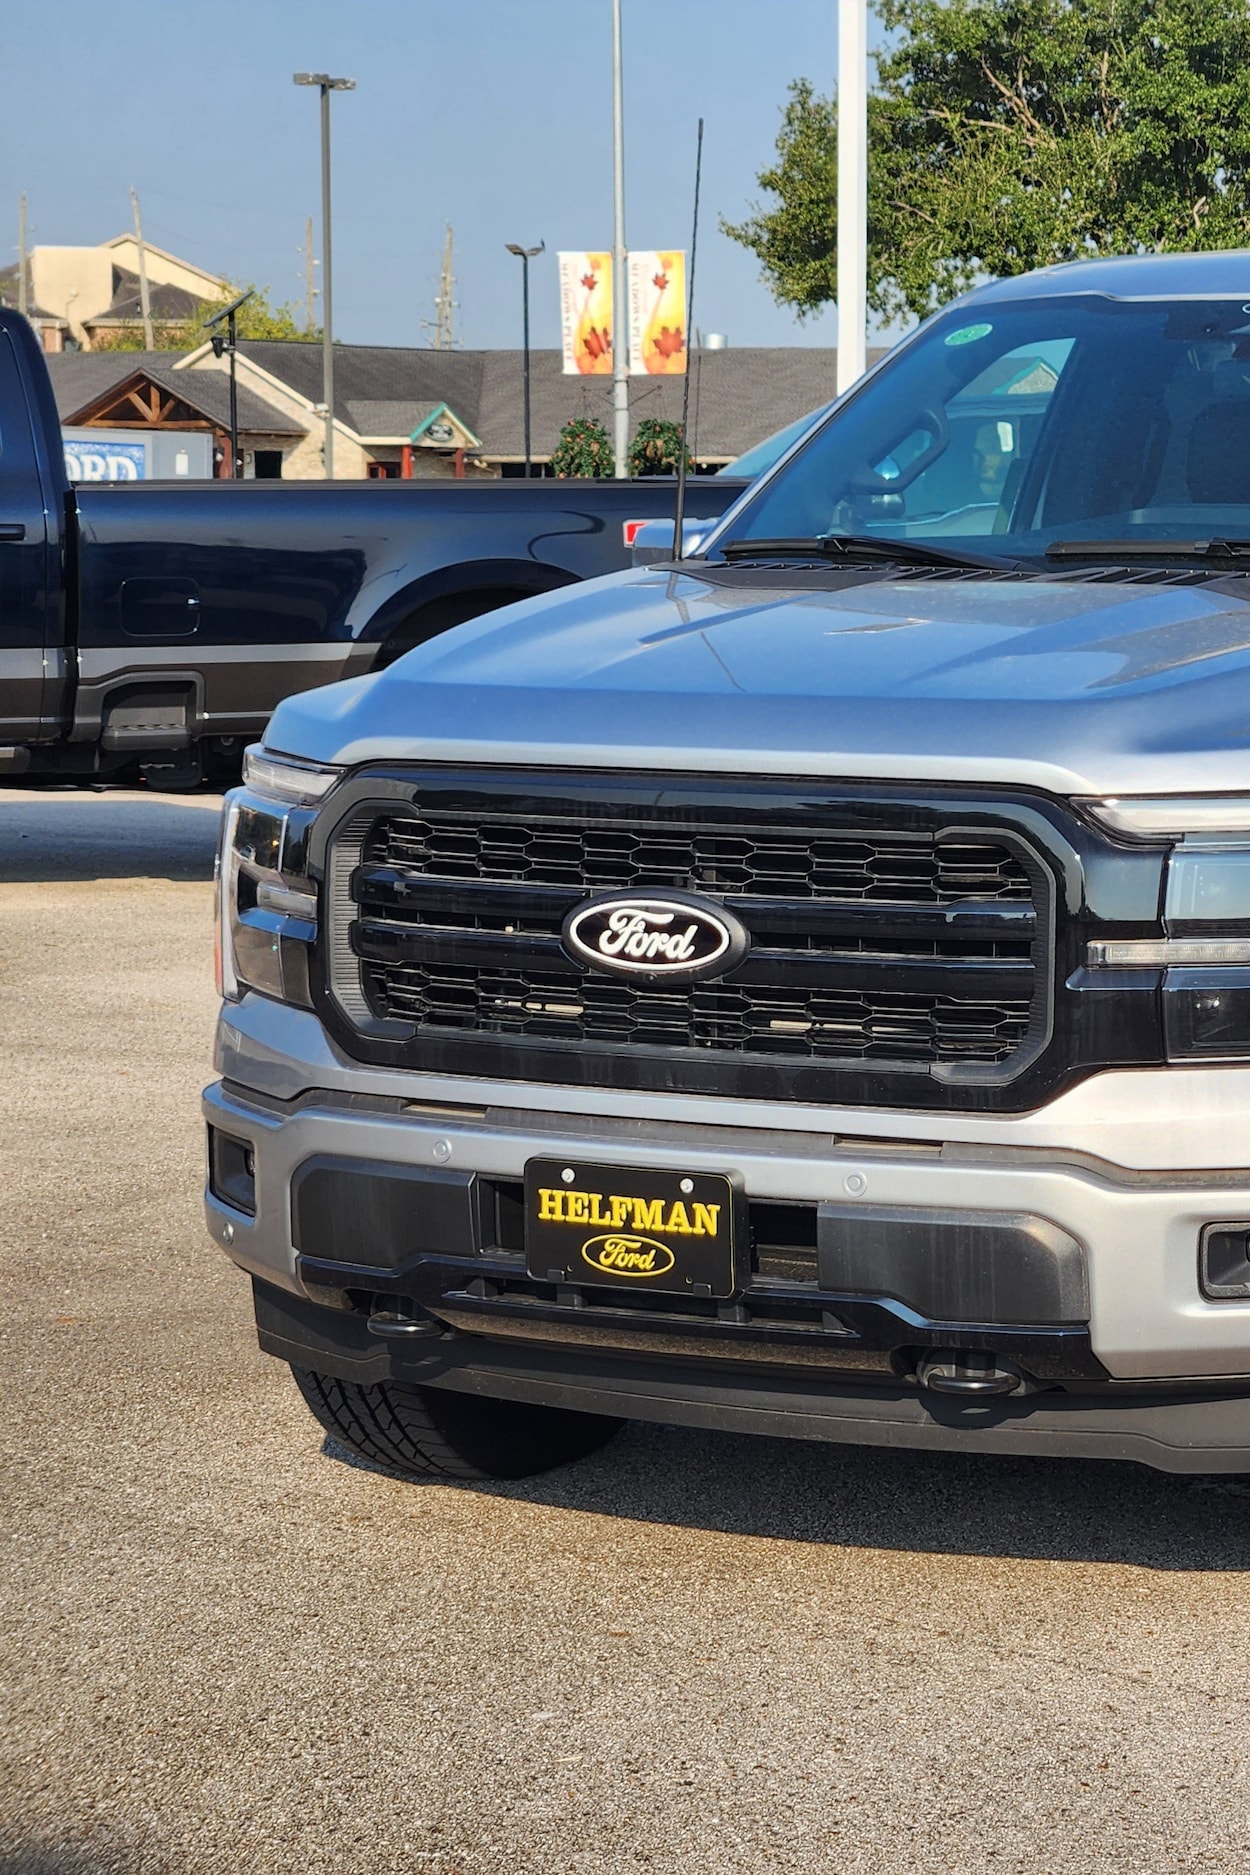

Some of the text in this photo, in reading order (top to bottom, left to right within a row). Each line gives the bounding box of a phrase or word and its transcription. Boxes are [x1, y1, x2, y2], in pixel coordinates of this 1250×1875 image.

[599, 908, 699, 960] Ford
[538, 1188, 721, 1236] HELFMAN
[599, 1238, 656, 1270] Ford
